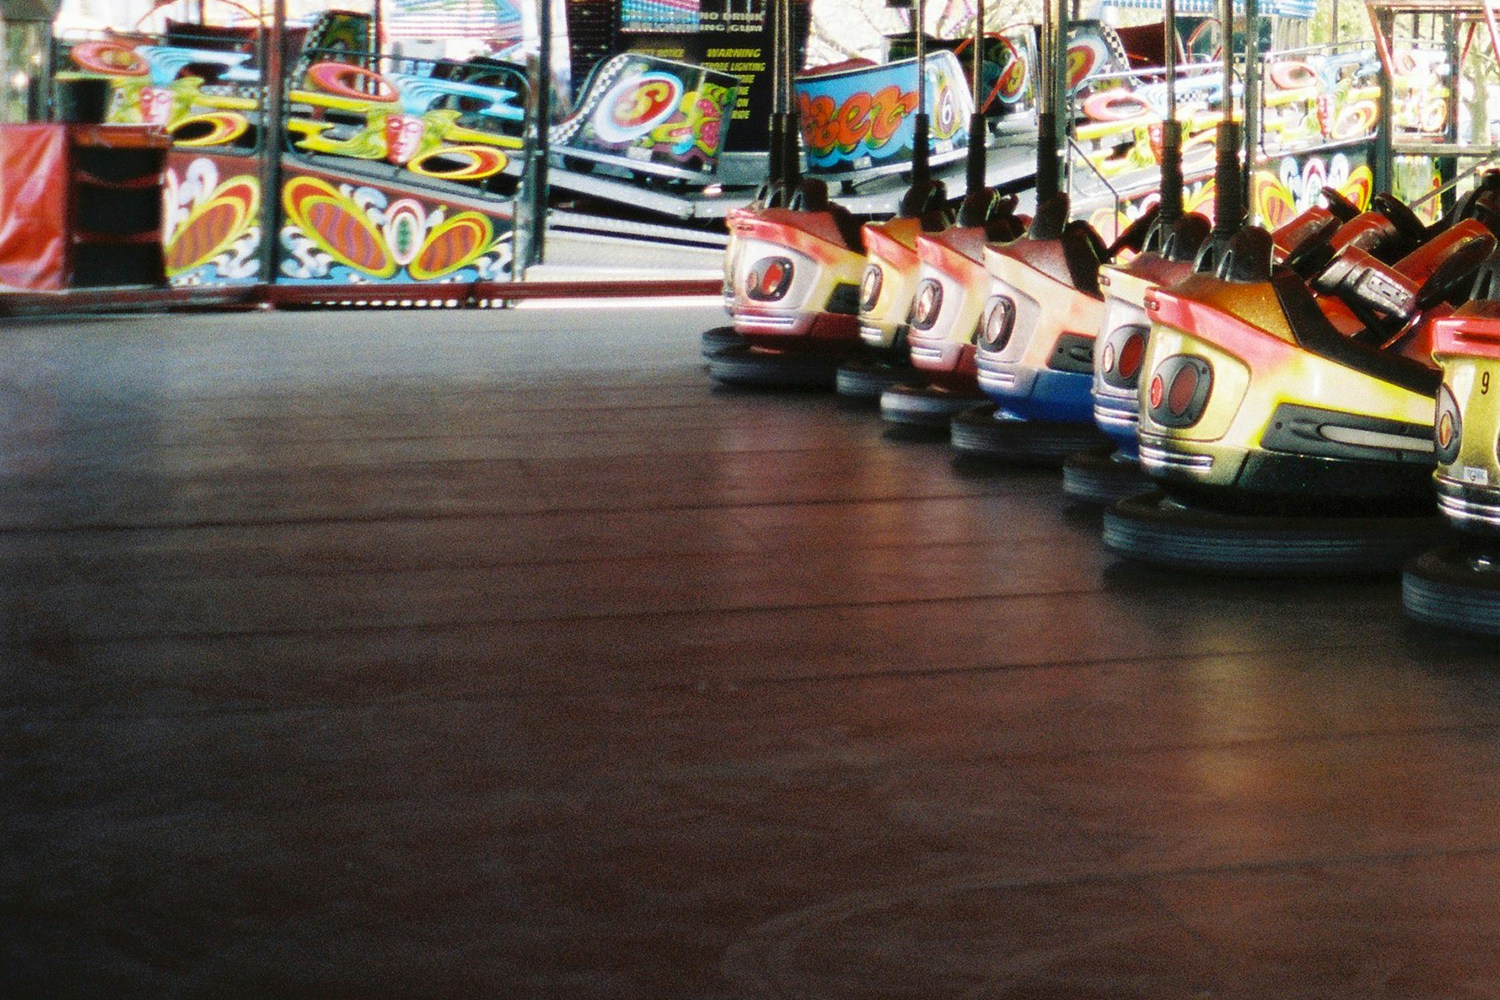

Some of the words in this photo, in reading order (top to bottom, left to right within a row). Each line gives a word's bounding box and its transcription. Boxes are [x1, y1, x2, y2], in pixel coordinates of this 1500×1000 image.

[706, 48, 762, 58] WARNING
[940, 89, 953, 126] 6
[1481, 371, 1490, 395] 9
